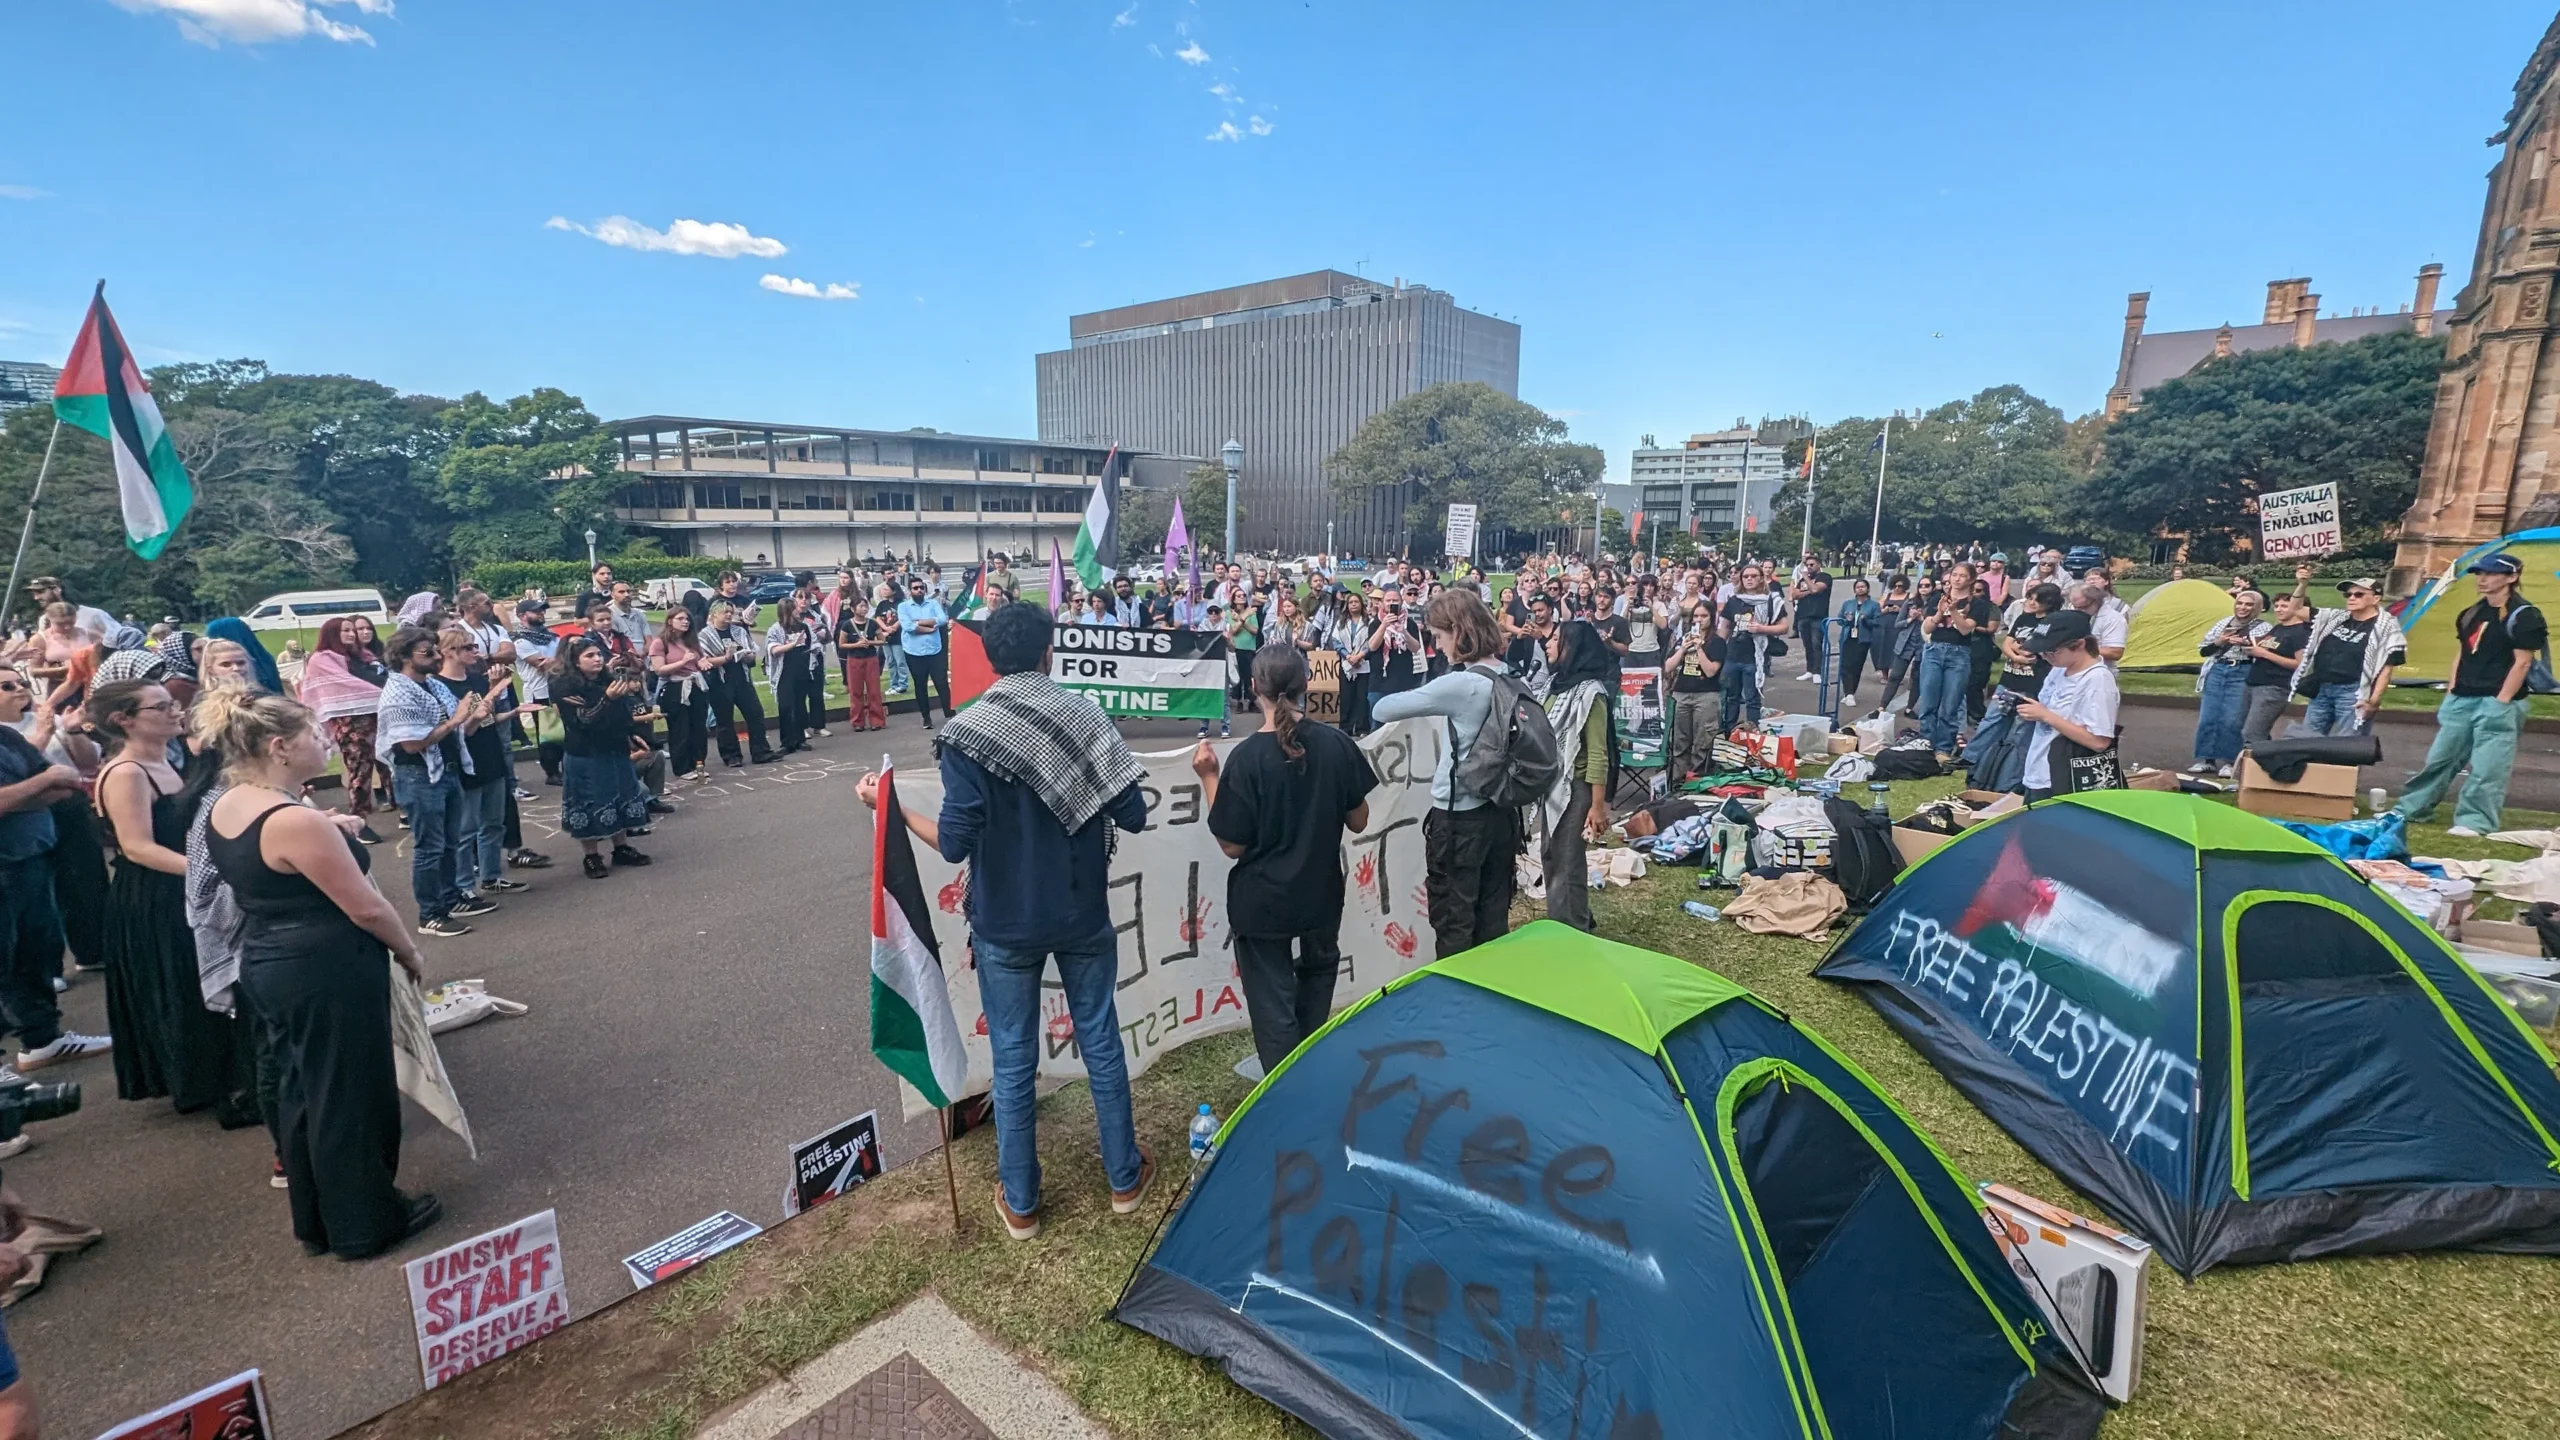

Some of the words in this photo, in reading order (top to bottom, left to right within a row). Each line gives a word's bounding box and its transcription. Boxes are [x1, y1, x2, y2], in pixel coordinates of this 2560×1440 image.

[2262, 487, 2333, 511] AUSTRALIA
[2287, 506, 2300, 515] IS
[2263, 510, 2334, 532] ENABLING
[2264, 530, 2337, 553] GENOCIDE
[1062, 658, 1118, 679] FOR
[2081, 776, 2090, 784] IS
[1884, 908, 1987, 1002] FREE
[1980, 957, 2198, 1155] PALESTINE
[799, 1141, 833, 1172] FREE
[801, 1130, 872, 1184] PALESTINE
[1341, 1039, 1633, 1256] Free
[423, 1227, 522, 1289] UNSW
[425, 1243, 553, 1335] STAFF
[428, 1301, 538, 1369] DESERVE
[544, 1292, 560, 1317] A
